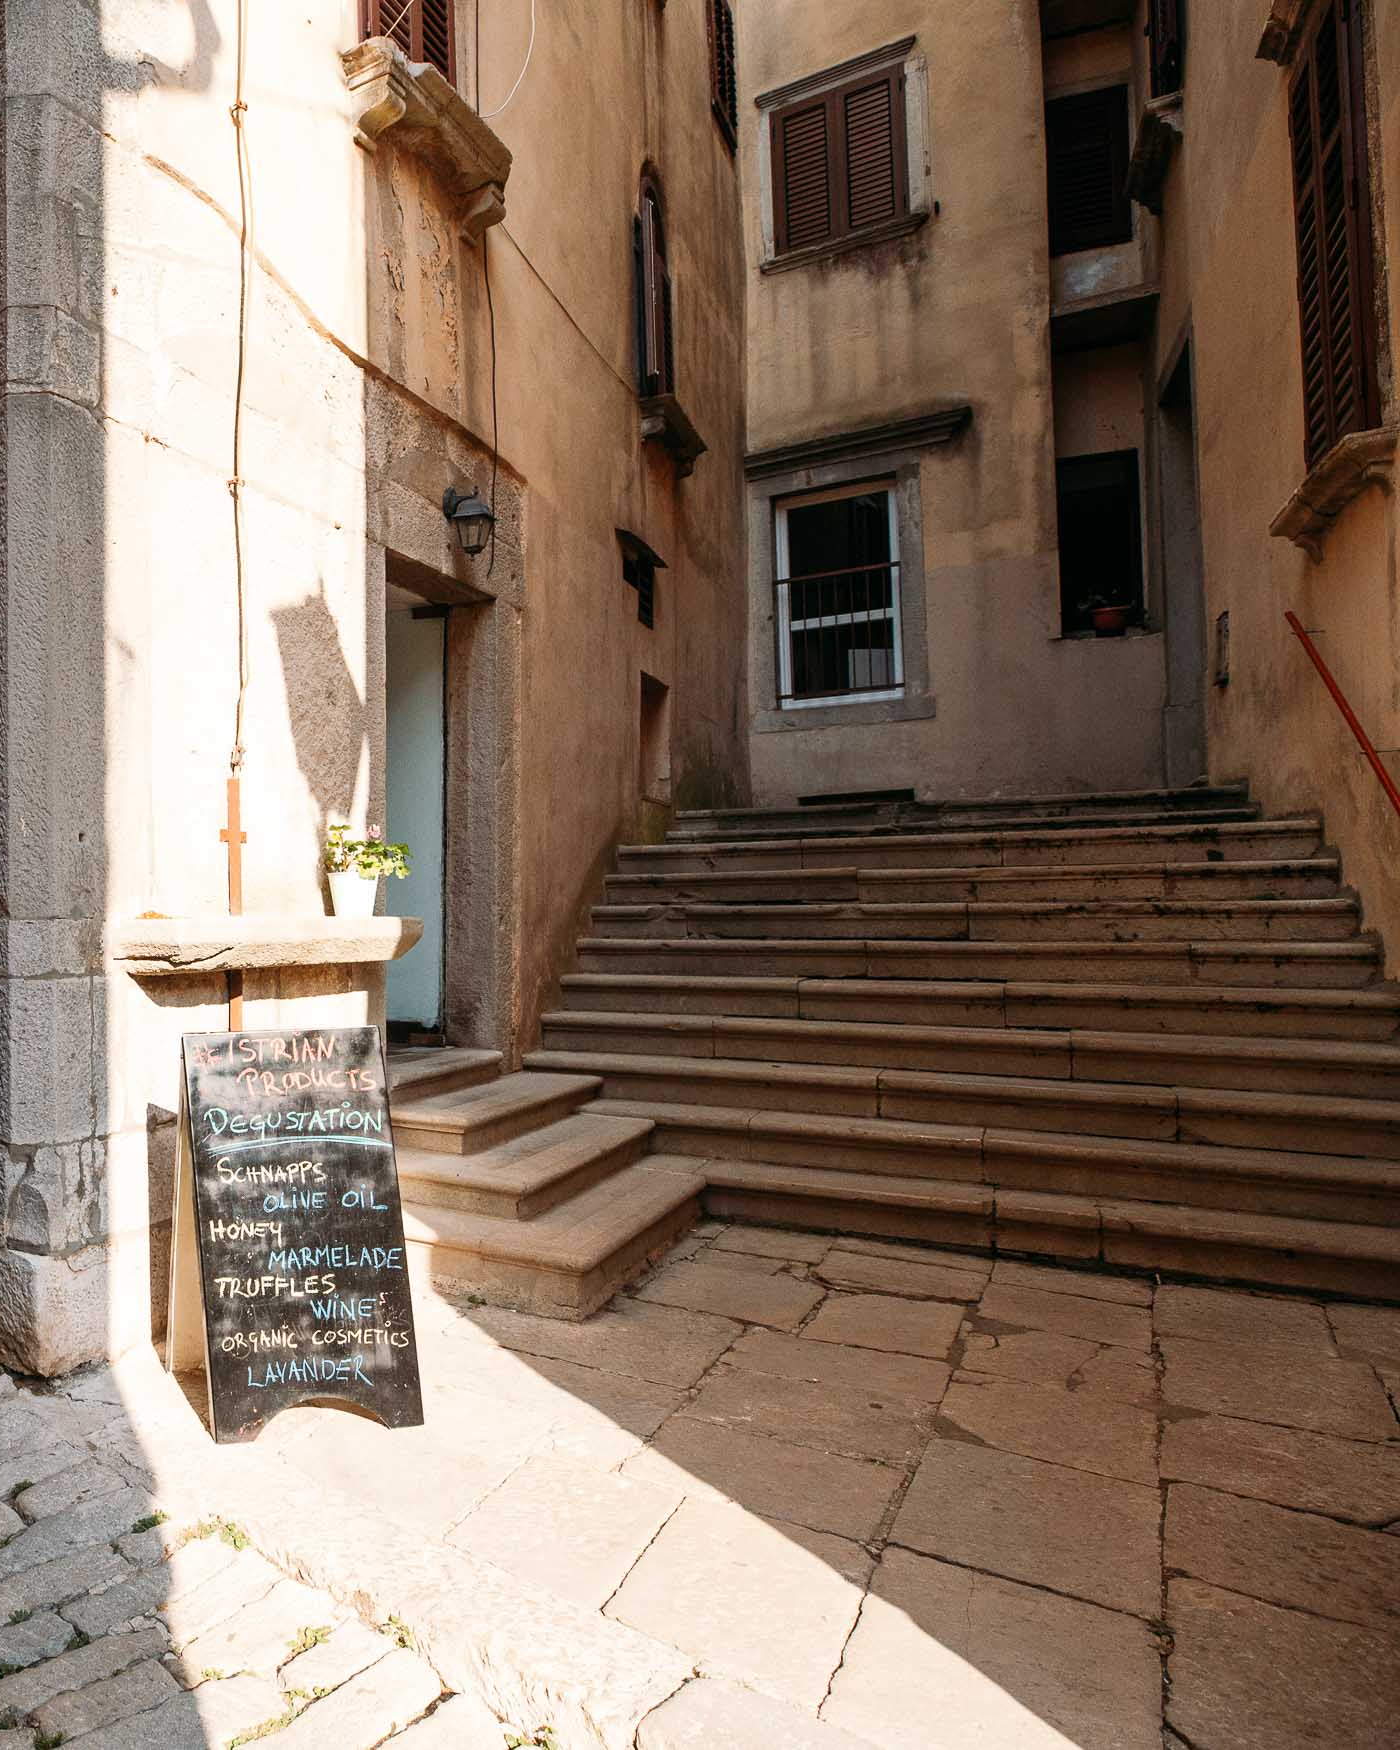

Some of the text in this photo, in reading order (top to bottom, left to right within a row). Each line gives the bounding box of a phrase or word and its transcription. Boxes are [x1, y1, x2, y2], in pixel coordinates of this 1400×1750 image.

[236, 1067, 377, 1096] PRODUCTS
[203, 1102, 382, 1140] DEGUSTATION
[216, 1157, 328, 1185] SCHNAPPS
[209, 1219, 282, 1247] HONEY
[268, 1246, 403, 1270] MARMELADE
[214, 1275, 337, 1298] TRUFFLES
[247, 1355, 374, 1387] LAVANDER
